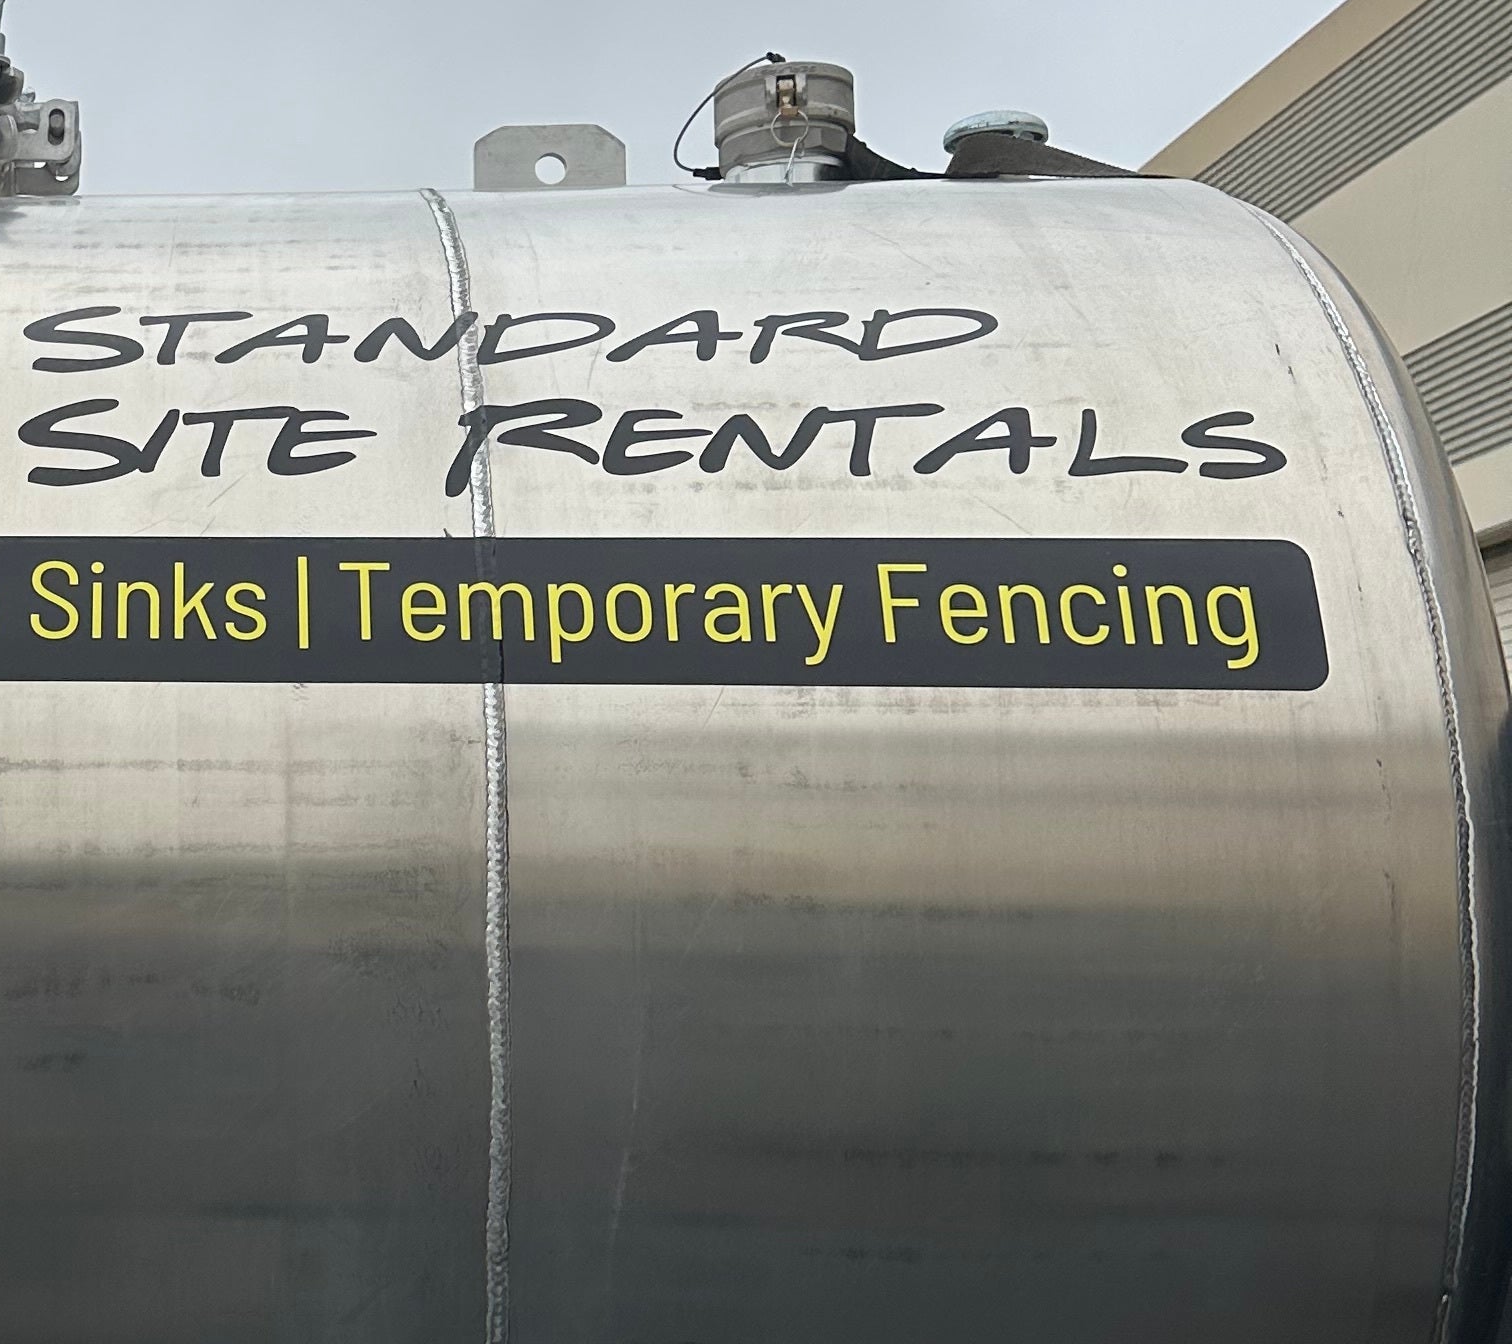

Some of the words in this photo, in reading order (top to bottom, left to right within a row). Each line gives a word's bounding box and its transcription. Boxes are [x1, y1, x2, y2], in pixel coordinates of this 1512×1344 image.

[24, 306, 998, 374] STANDARD
[18, 398, 377, 487] SITE
[445, 398, 1287, 497] RENTALS
[29, 559, 267, 642] Sinks
[339, 561, 843, 667] Temporary
[876, 562, 1260, 670] Fencing
